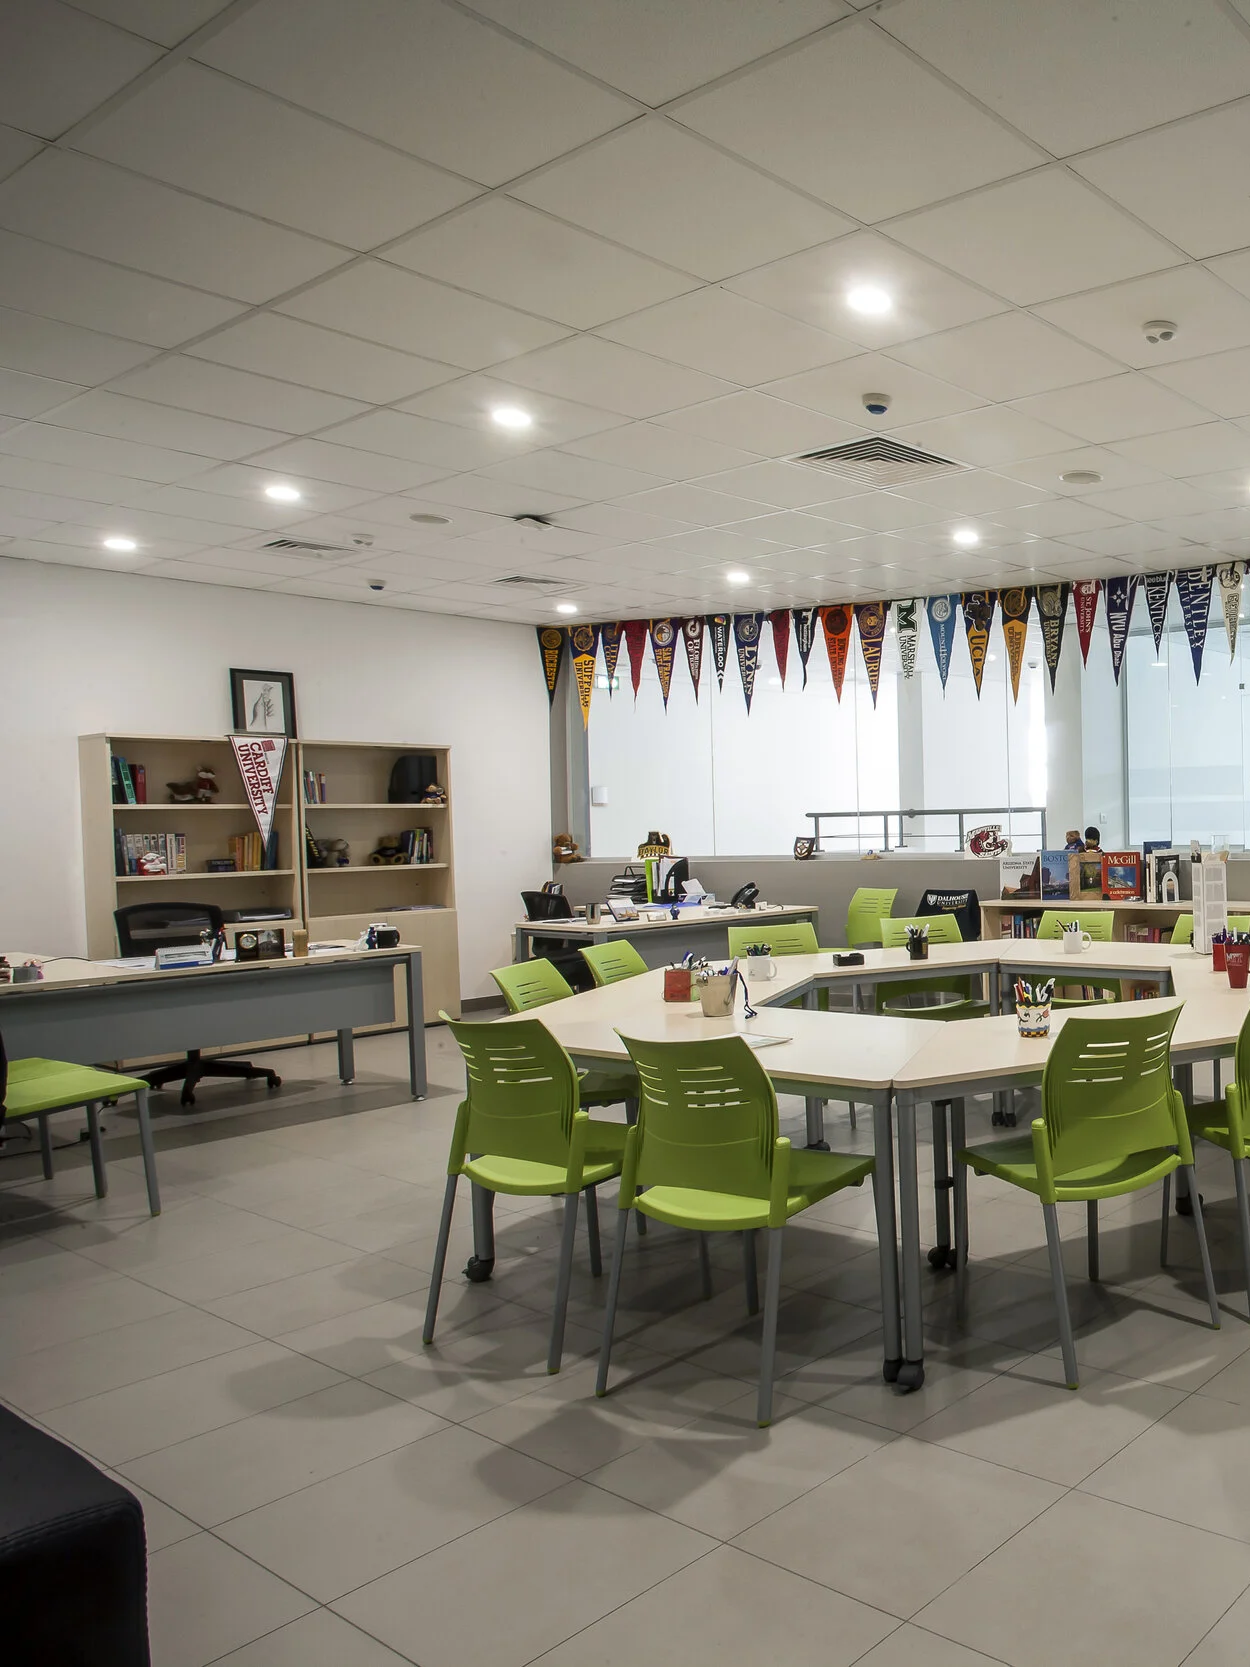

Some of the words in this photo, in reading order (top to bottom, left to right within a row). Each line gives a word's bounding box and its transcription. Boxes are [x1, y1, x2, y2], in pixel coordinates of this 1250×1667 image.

[897, 602, 918, 633] M
[1109, 612, 1127, 631] NYU
[1150, 585, 1166, 645] KENTUCKY
[1178, 573, 1197, 648] UNIVERSITY
[1187, 570, 1212, 648] BENTLEY
[662, 648, 673, 661] SAN
[827, 638, 838, 654] STATE
[901, 636, 909, 680] UNIVERSITY
[907, 634, 917, 680] MARSHALL
[969, 635, 986, 677] UCLA
[1043, 621, 1051, 667] UNIVERSITY
[1050, 620, 1060, 668] BRYANT
[1113, 633, 1125, 649] Abu
[544, 649, 558, 691] ROCHESTER
[575, 662, 586, 704] UNIVERSITY
[581, 660, 594, 708] SUFFOLK
[738, 648, 747, 693] UNIVERSITY
[745, 646, 758, 695] LYNN
[861, 638, 883, 692] LAURIER
[237, 744, 269, 815] UNIVERSITY
[250, 742, 274, 794] CARDIFF
[638, 846, 668, 856] BAYLOR
[1043, 854, 1068, 862] BOSTO
[1107, 855, 1136, 865] McGill
[938, 893, 969, 901] DALHOUSIE
